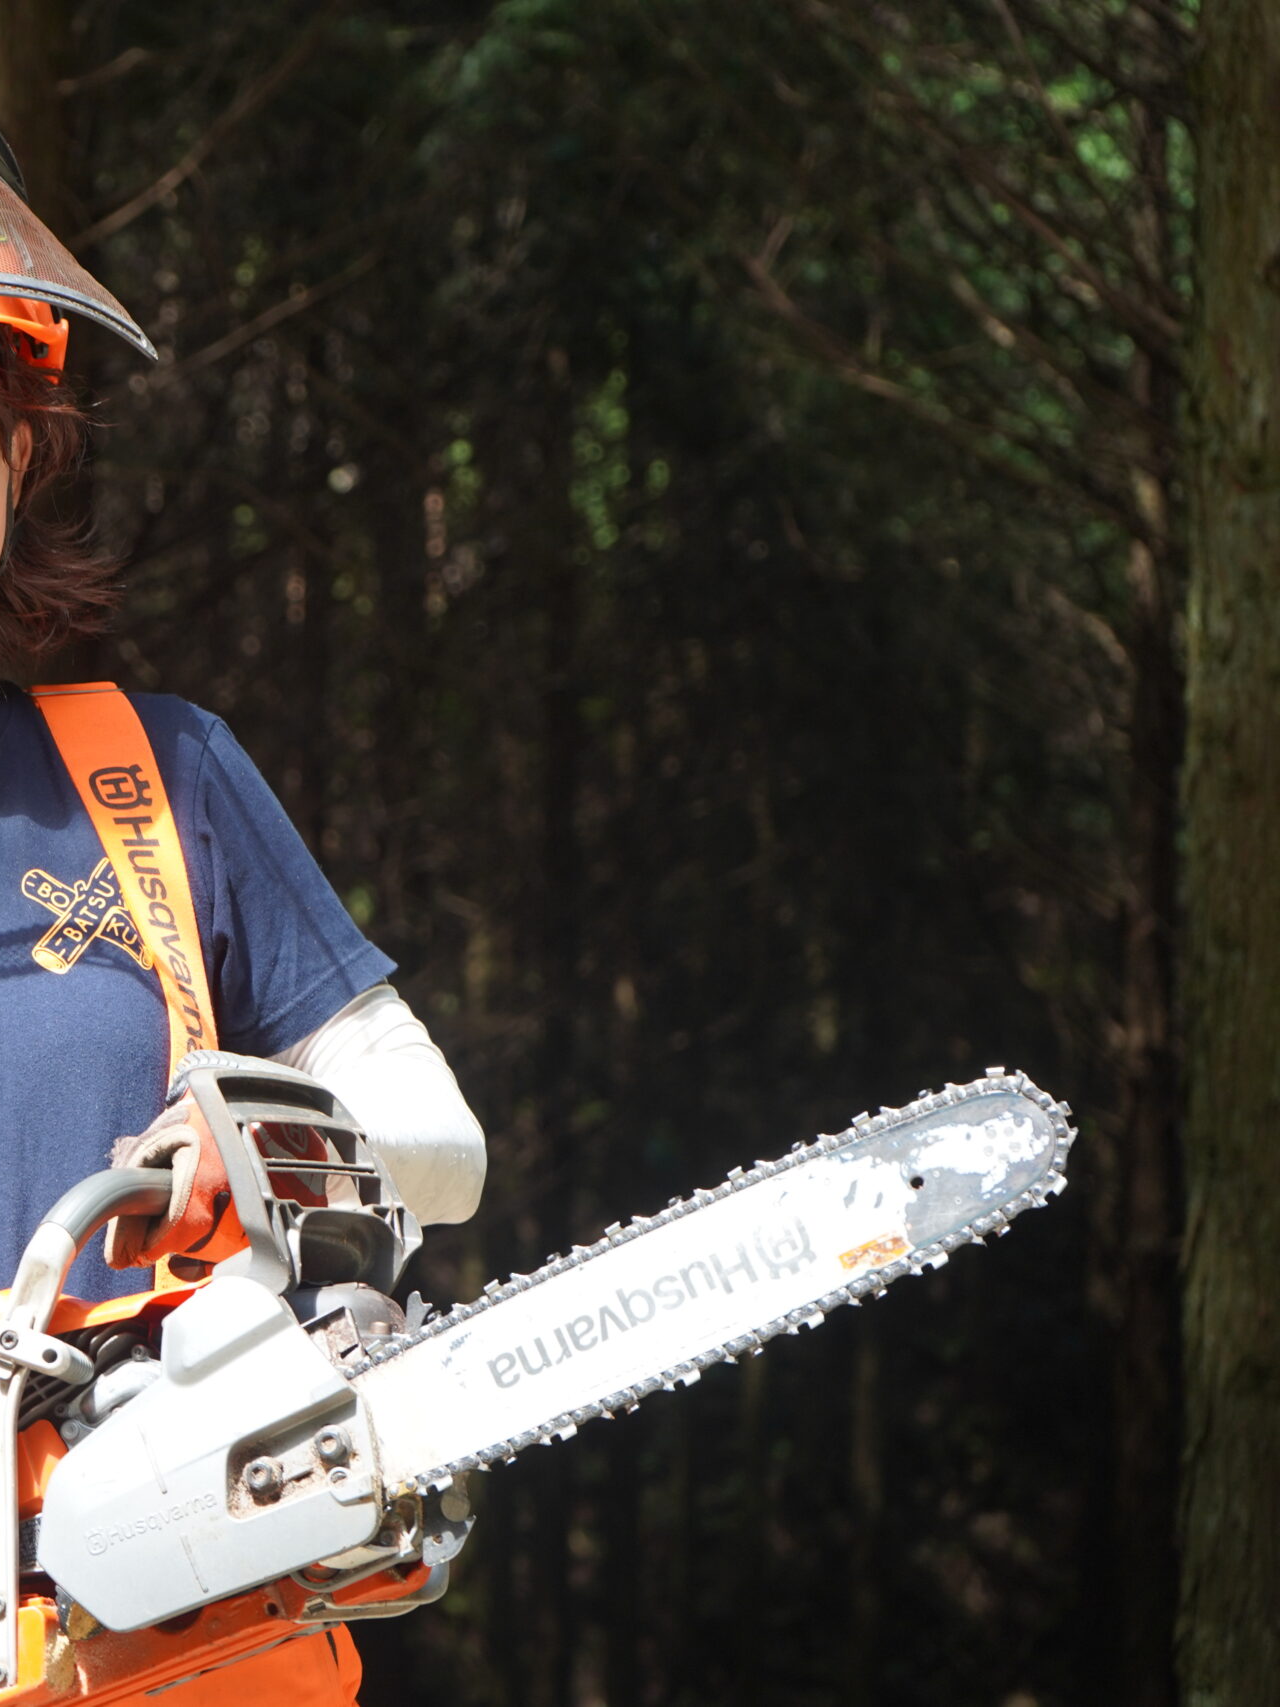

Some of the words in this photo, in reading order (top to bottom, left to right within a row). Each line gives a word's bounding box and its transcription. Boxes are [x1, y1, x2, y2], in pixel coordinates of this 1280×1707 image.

[37, 882, 70, 908] BO
[62, 880, 115, 942] BATSU
[106, 917, 138, 945] KU
[486, 1240, 759, 1389] Husqvarna
[106, 1492, 218, 1546] Husqvarna
